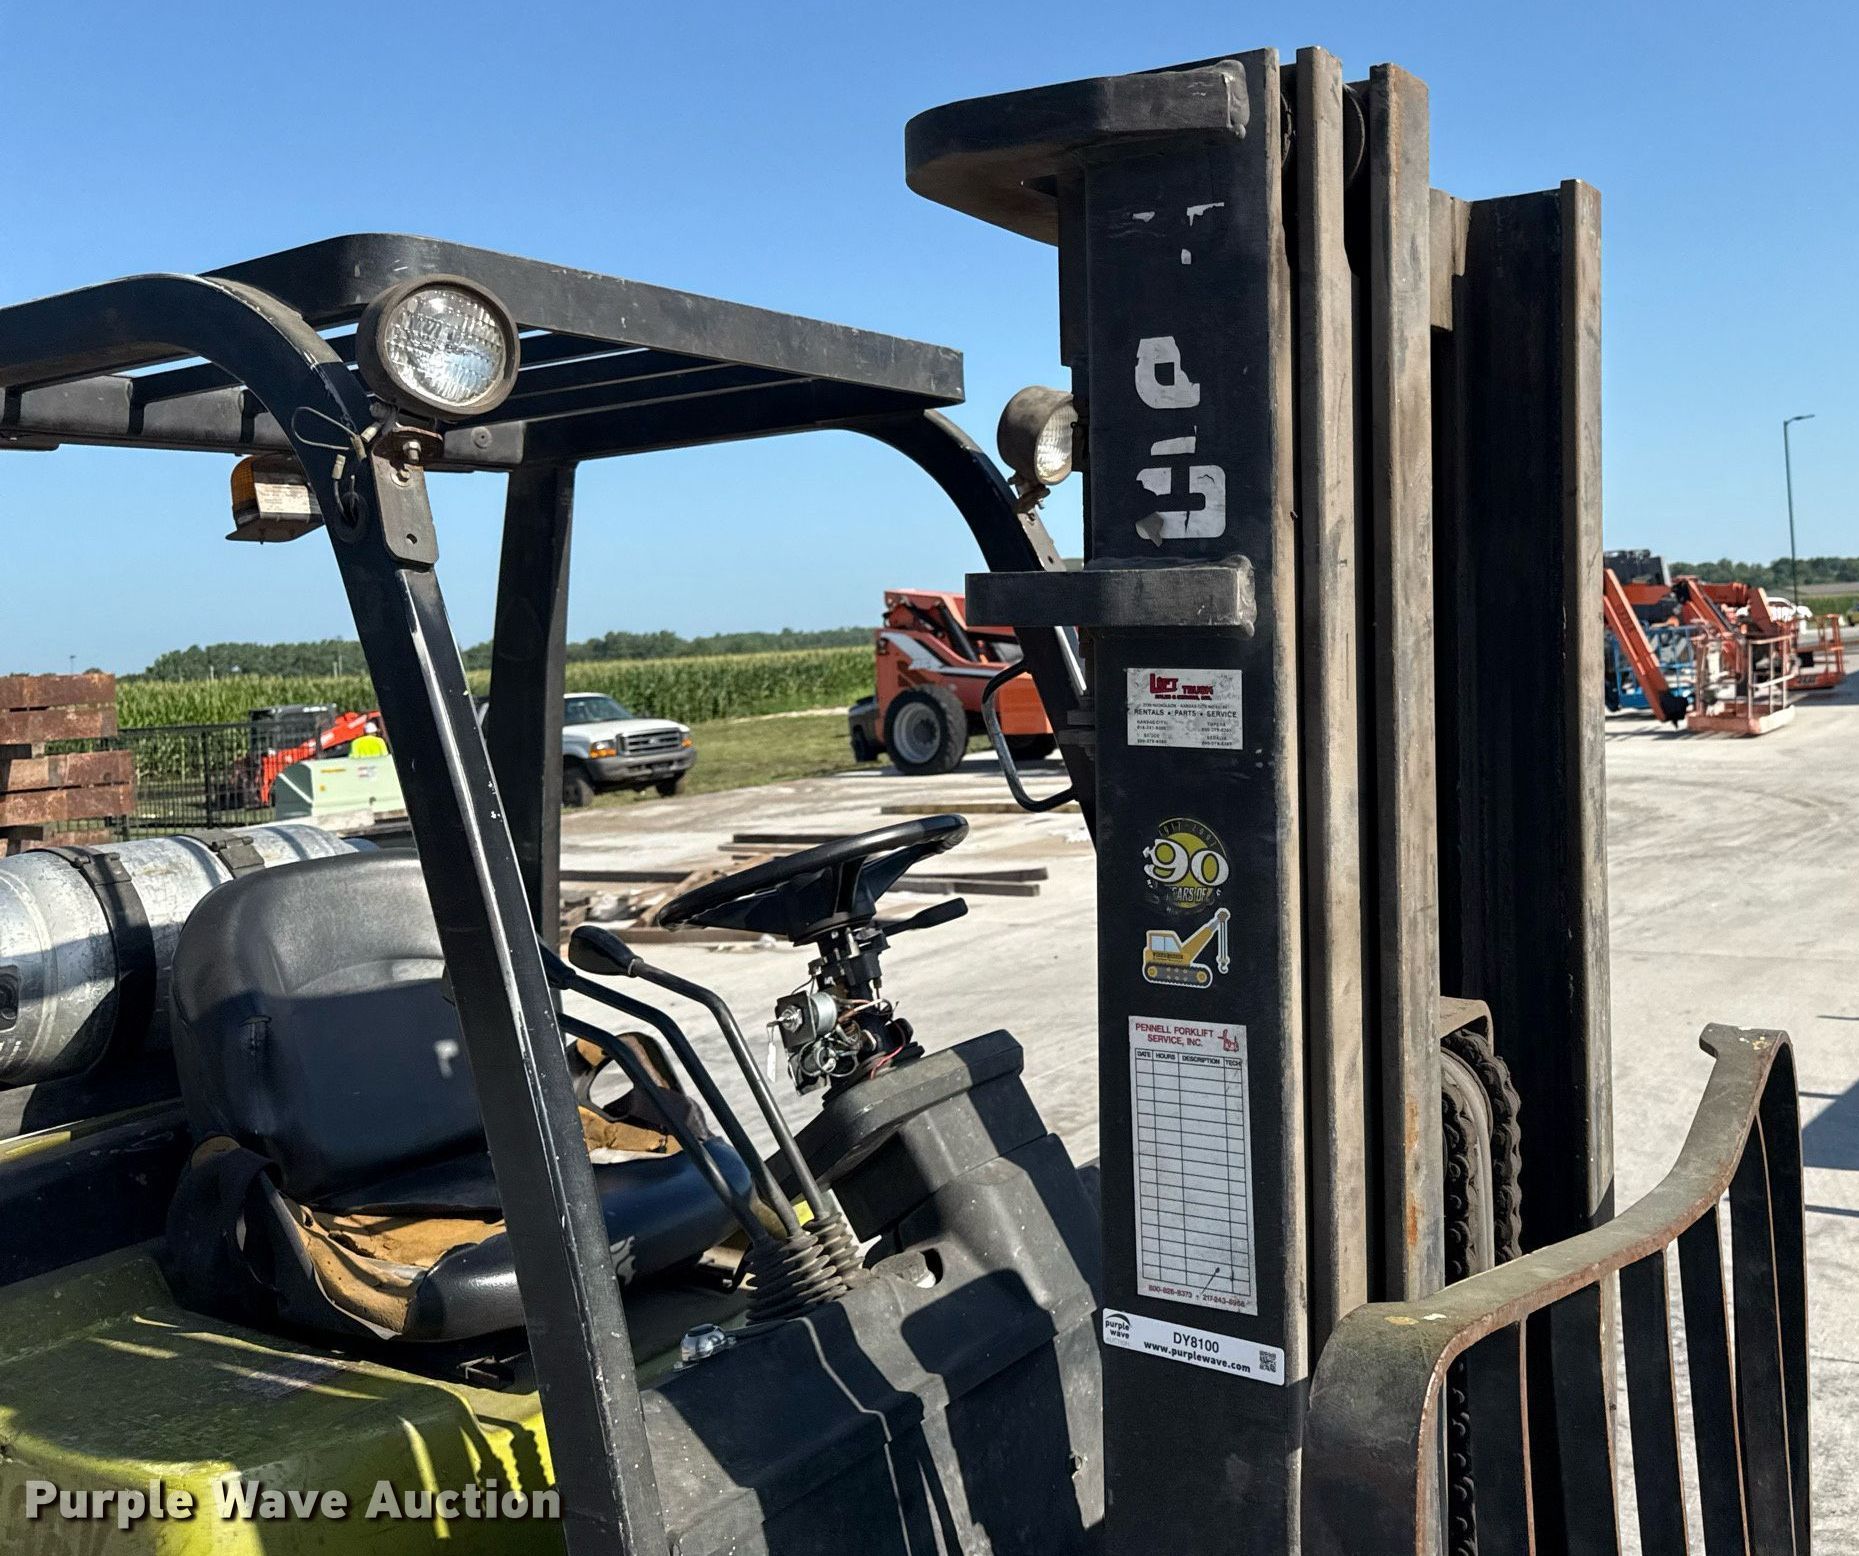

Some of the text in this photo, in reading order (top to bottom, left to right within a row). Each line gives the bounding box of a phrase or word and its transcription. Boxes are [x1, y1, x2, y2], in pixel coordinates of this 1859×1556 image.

[1134, 708, 1237, 718] RENTALS PARTS SERVICE
[1143, 838, 1230, 886] 90
[1135, 1022, 1214, 1038] PENNELL FORKLIFT
[1147, 1034, 1203, 1047] SERVICE, INC.
[1155, 1052, 1176, 1060] HOURS
[1182, 1055, 1220, 1065] DESCRIPTION
[1225, 1059, 1242, 1067] TECH
[1105, 1320, 1130, 1331] purple
[1109, 1329, 1130, 1339] wave
[1173, 1331, 1220, 1354] DY8100
[1143, 1340, 1251, 1373] www.purplewave.com
